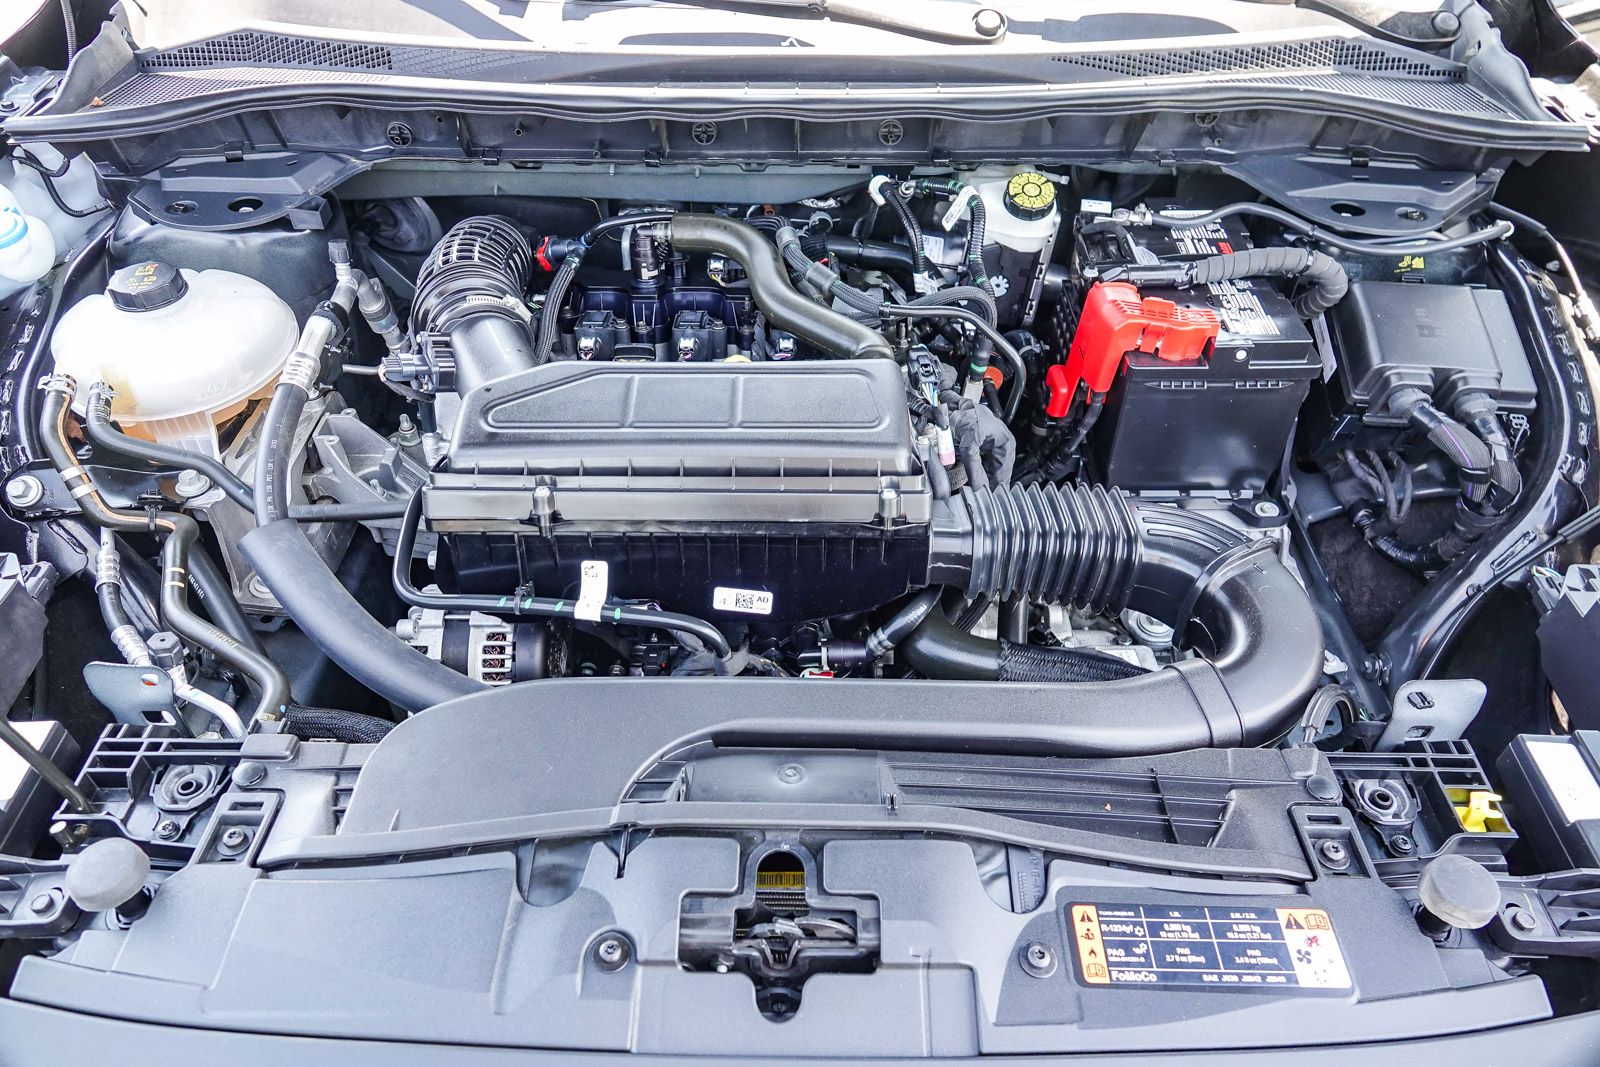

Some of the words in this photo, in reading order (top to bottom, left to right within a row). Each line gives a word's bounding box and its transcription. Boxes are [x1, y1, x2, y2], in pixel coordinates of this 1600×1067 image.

[1100, 923, 1134, 933] R-1234yf
[1106, 948, 1126, 957] PAG
[1110, 970, 1158, 982] FoMoCo
